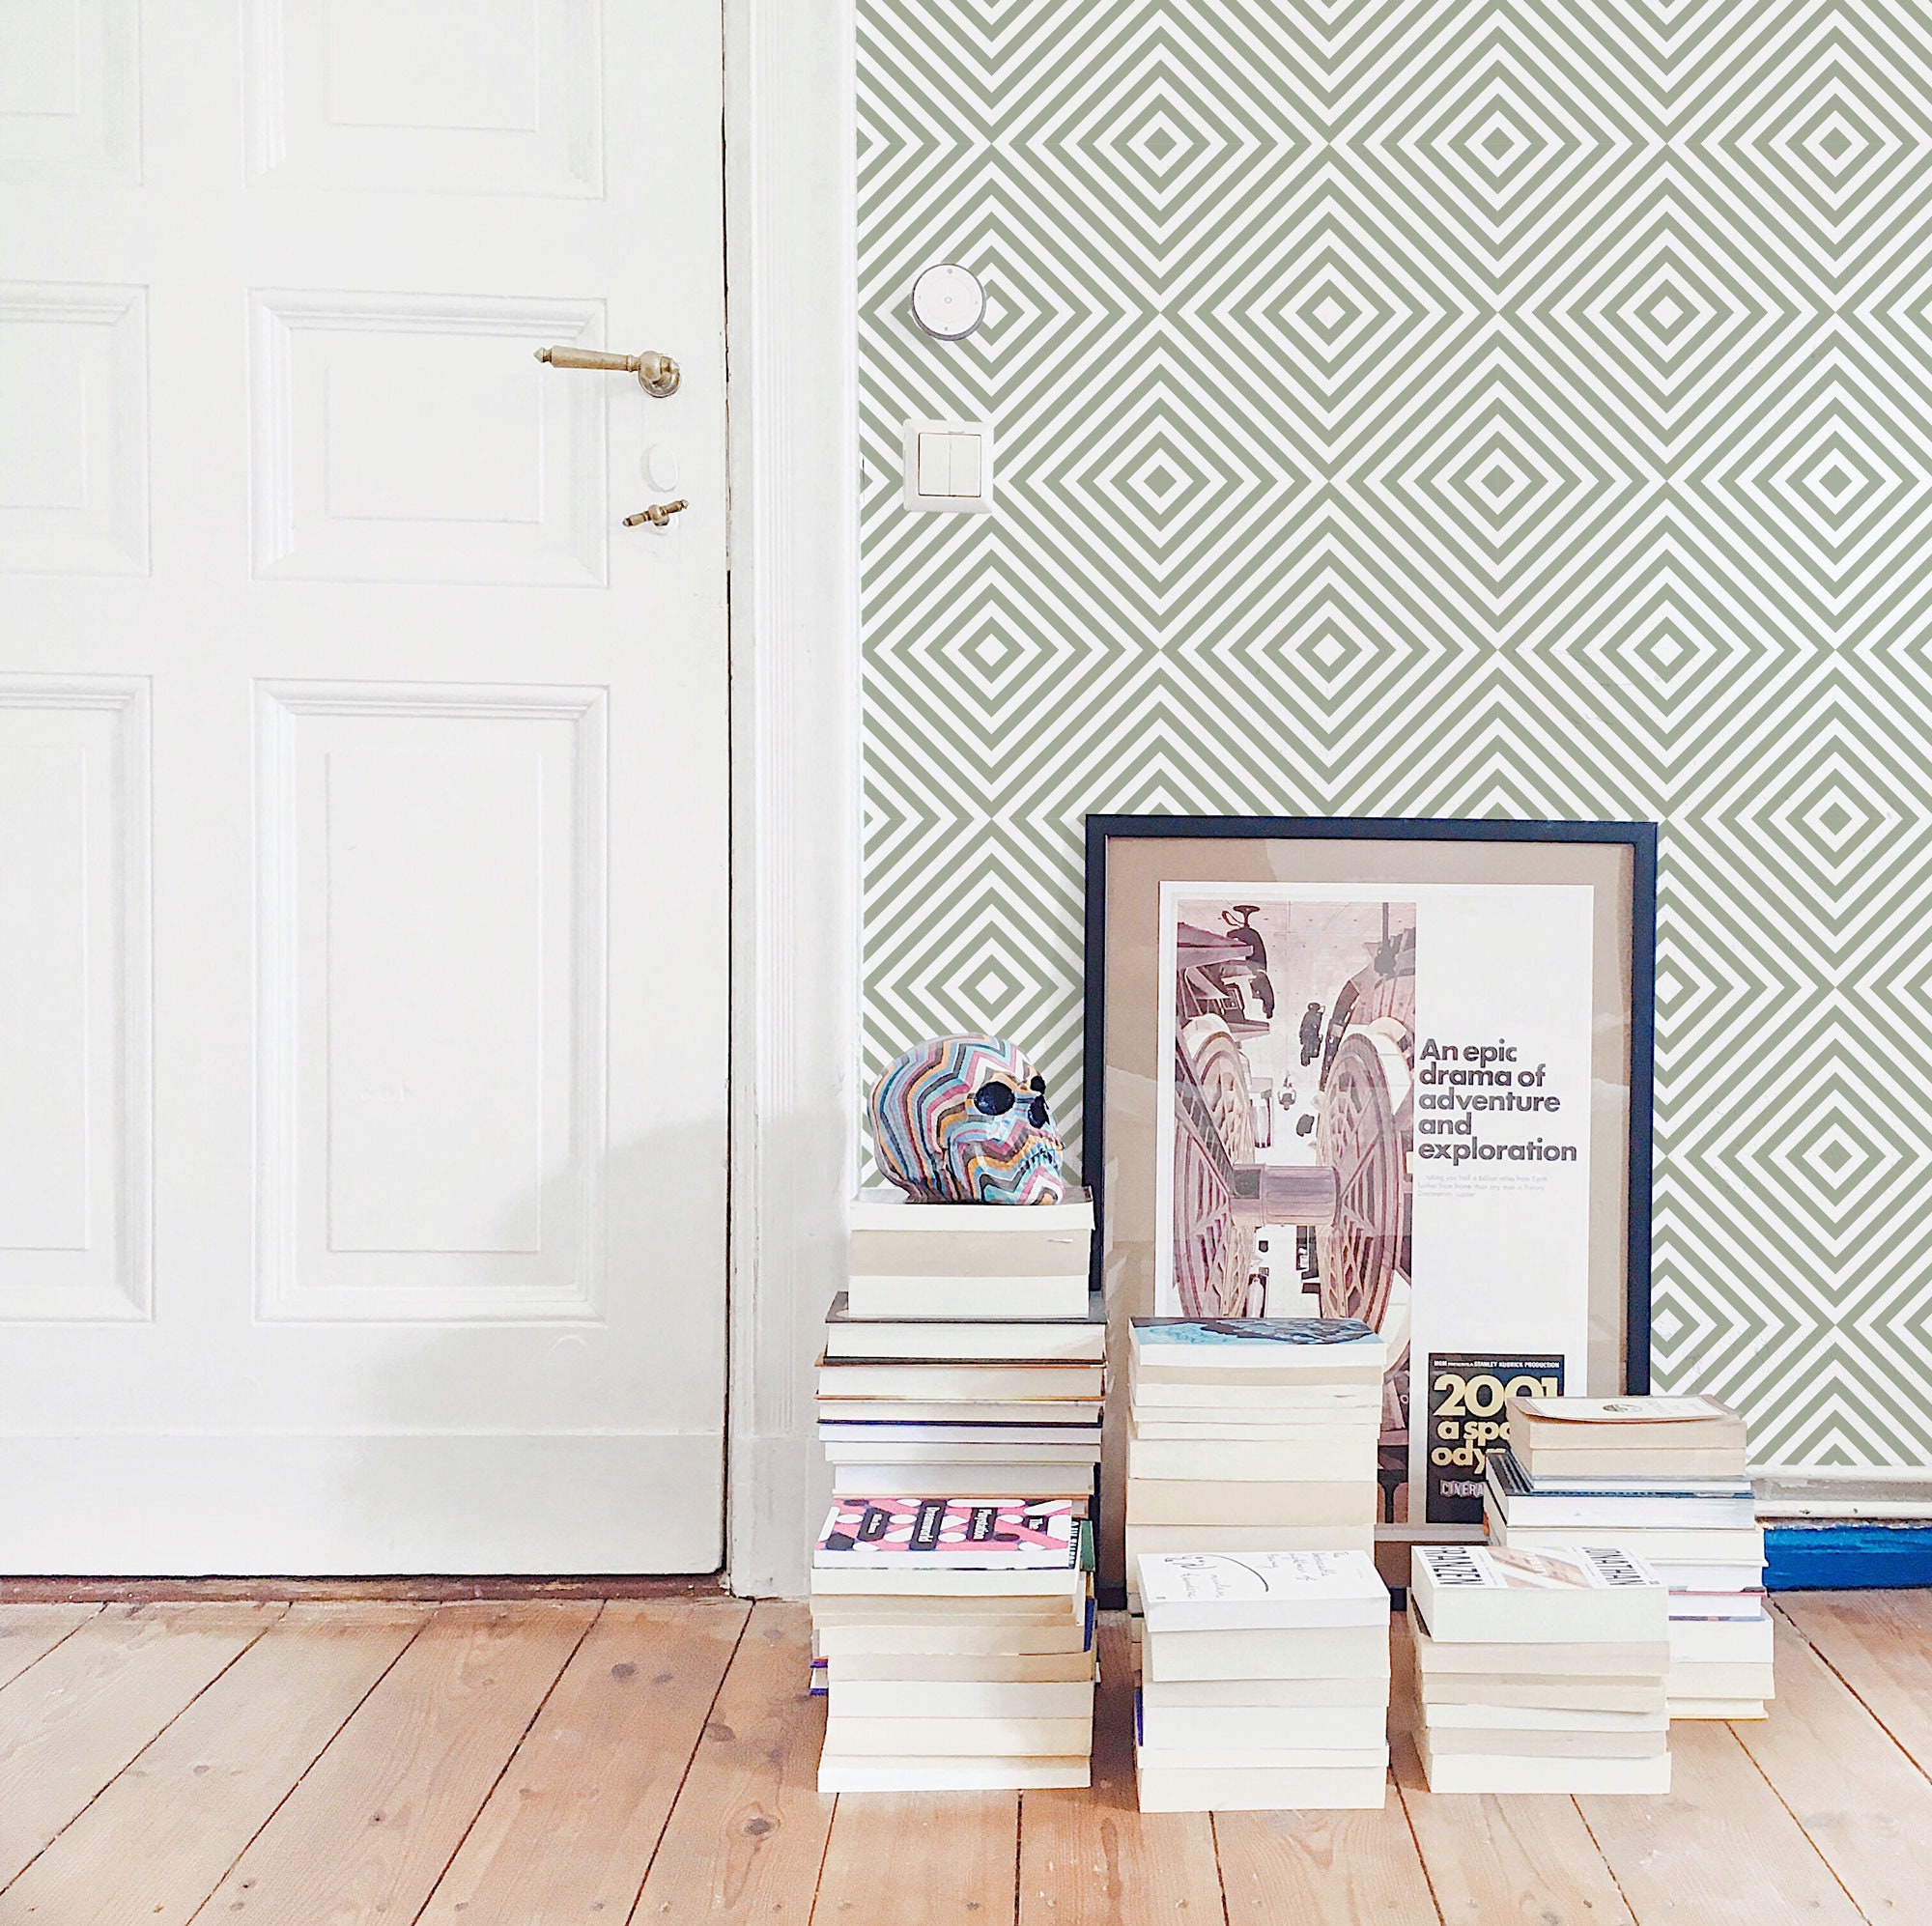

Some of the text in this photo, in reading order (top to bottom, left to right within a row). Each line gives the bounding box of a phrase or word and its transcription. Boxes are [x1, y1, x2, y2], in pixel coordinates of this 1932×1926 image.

[1420, 1038, 1518, 1068] An epic
[1419, 1062, 1547, 1088] drama of
[1418, 1087, 1561, 1112] adventure
[1418, 1112, 1472, 1135] and
[1418, 1136, 1577, 1166] exploration
[1437, 1421, 1460, 1440] a
[1029, 1517, 1043, 1530] The
